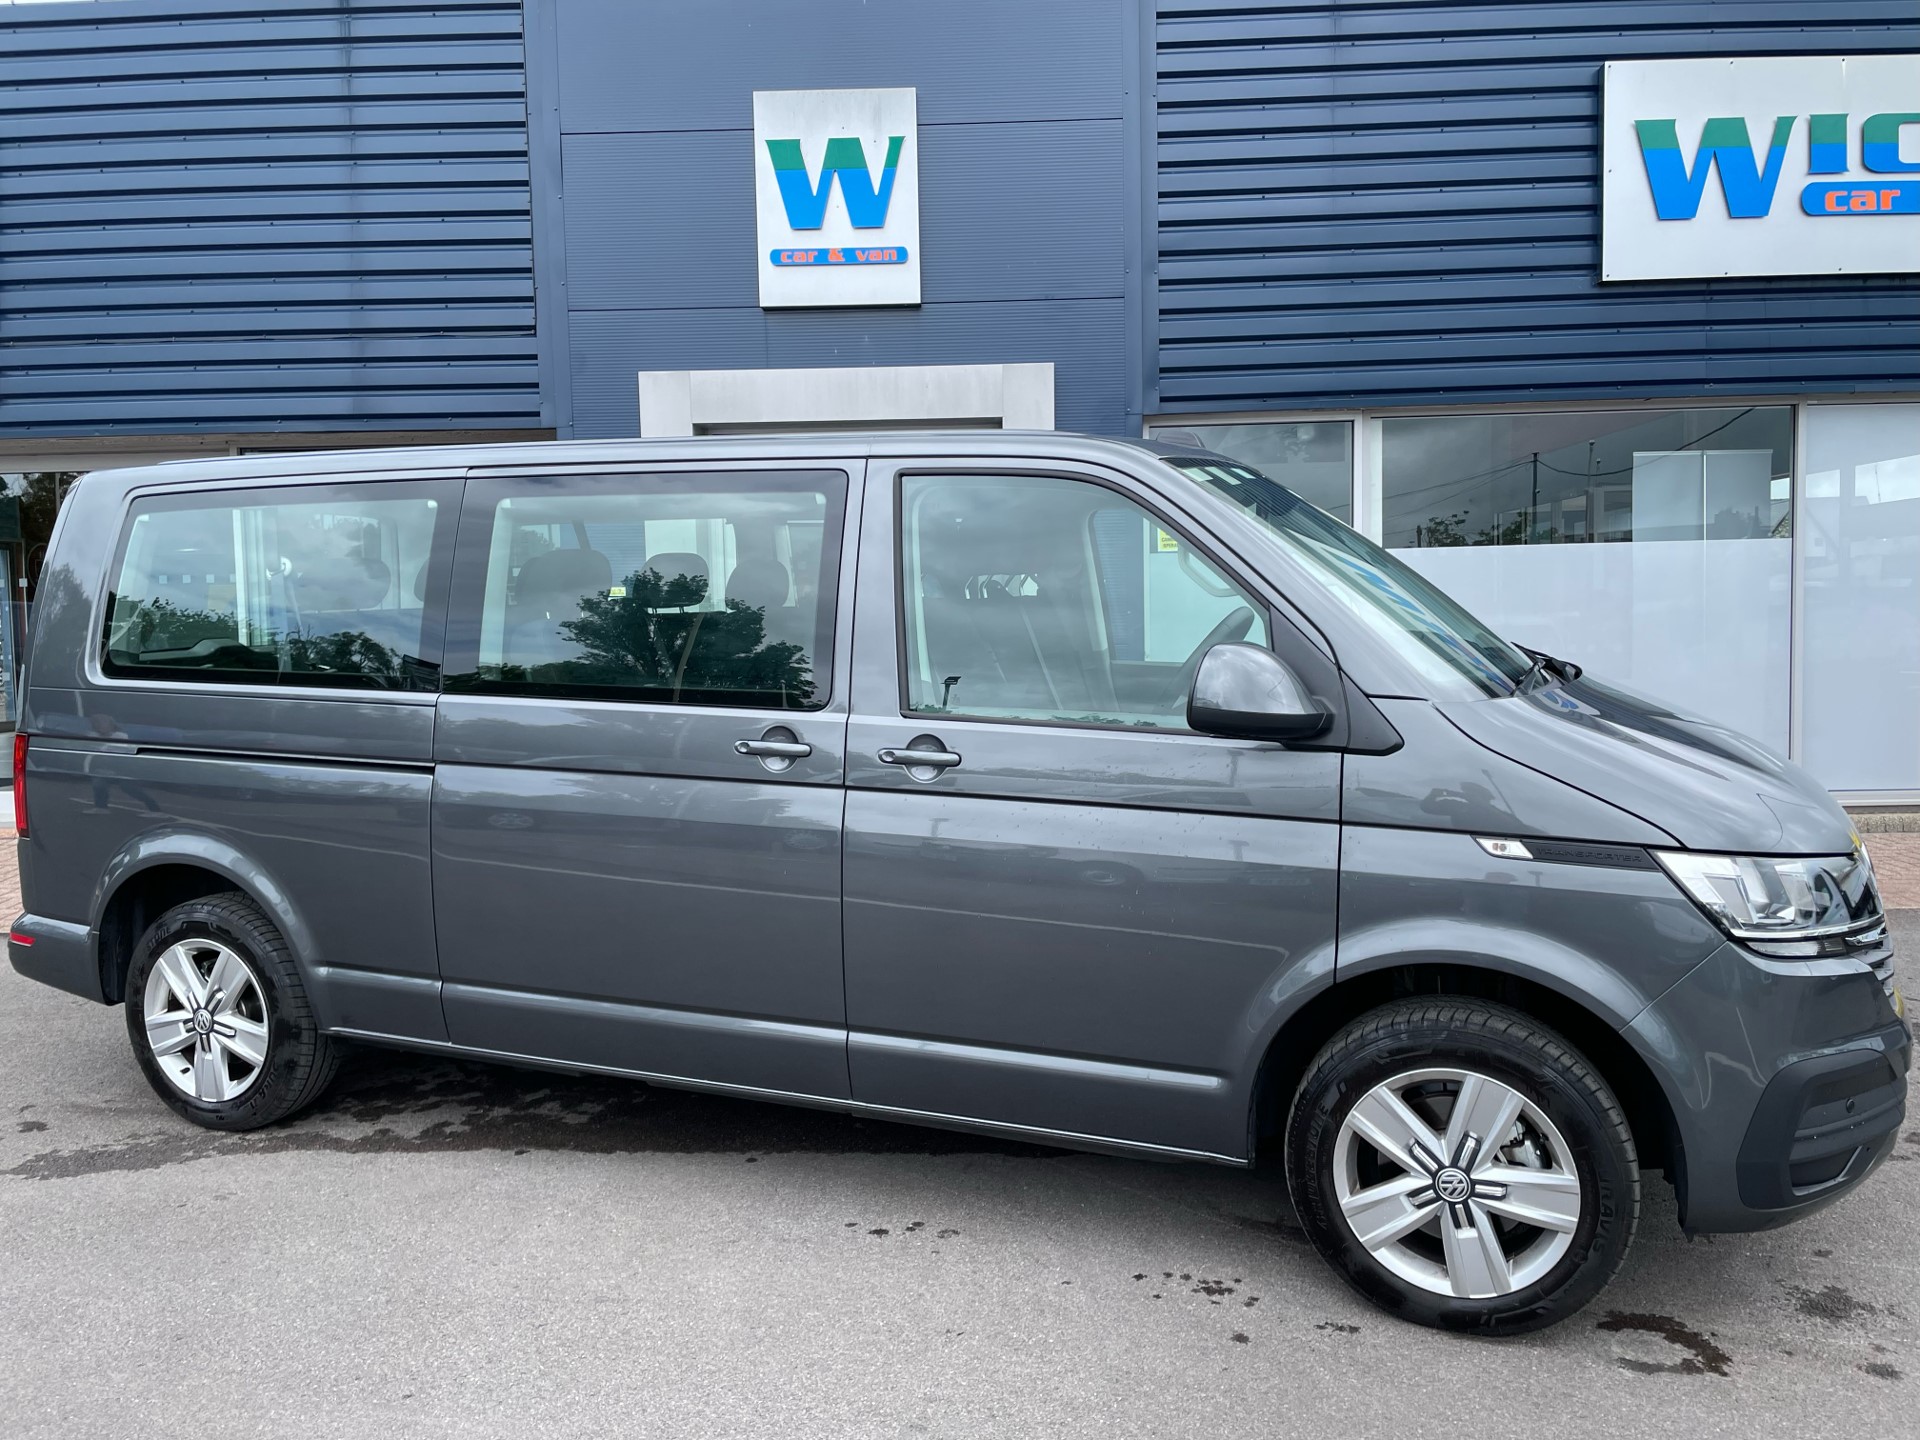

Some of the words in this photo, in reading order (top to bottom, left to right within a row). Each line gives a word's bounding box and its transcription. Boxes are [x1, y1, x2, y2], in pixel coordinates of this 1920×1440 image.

[765, 136, 905, 230] W
[1824, 189, 1901, 211] car
[780, 250, 818, 263] car
[828, 248, 845, 262] &
[855, 249, 897, 262] van
[1537, 848, 1643, 862] TRANSPORTER
